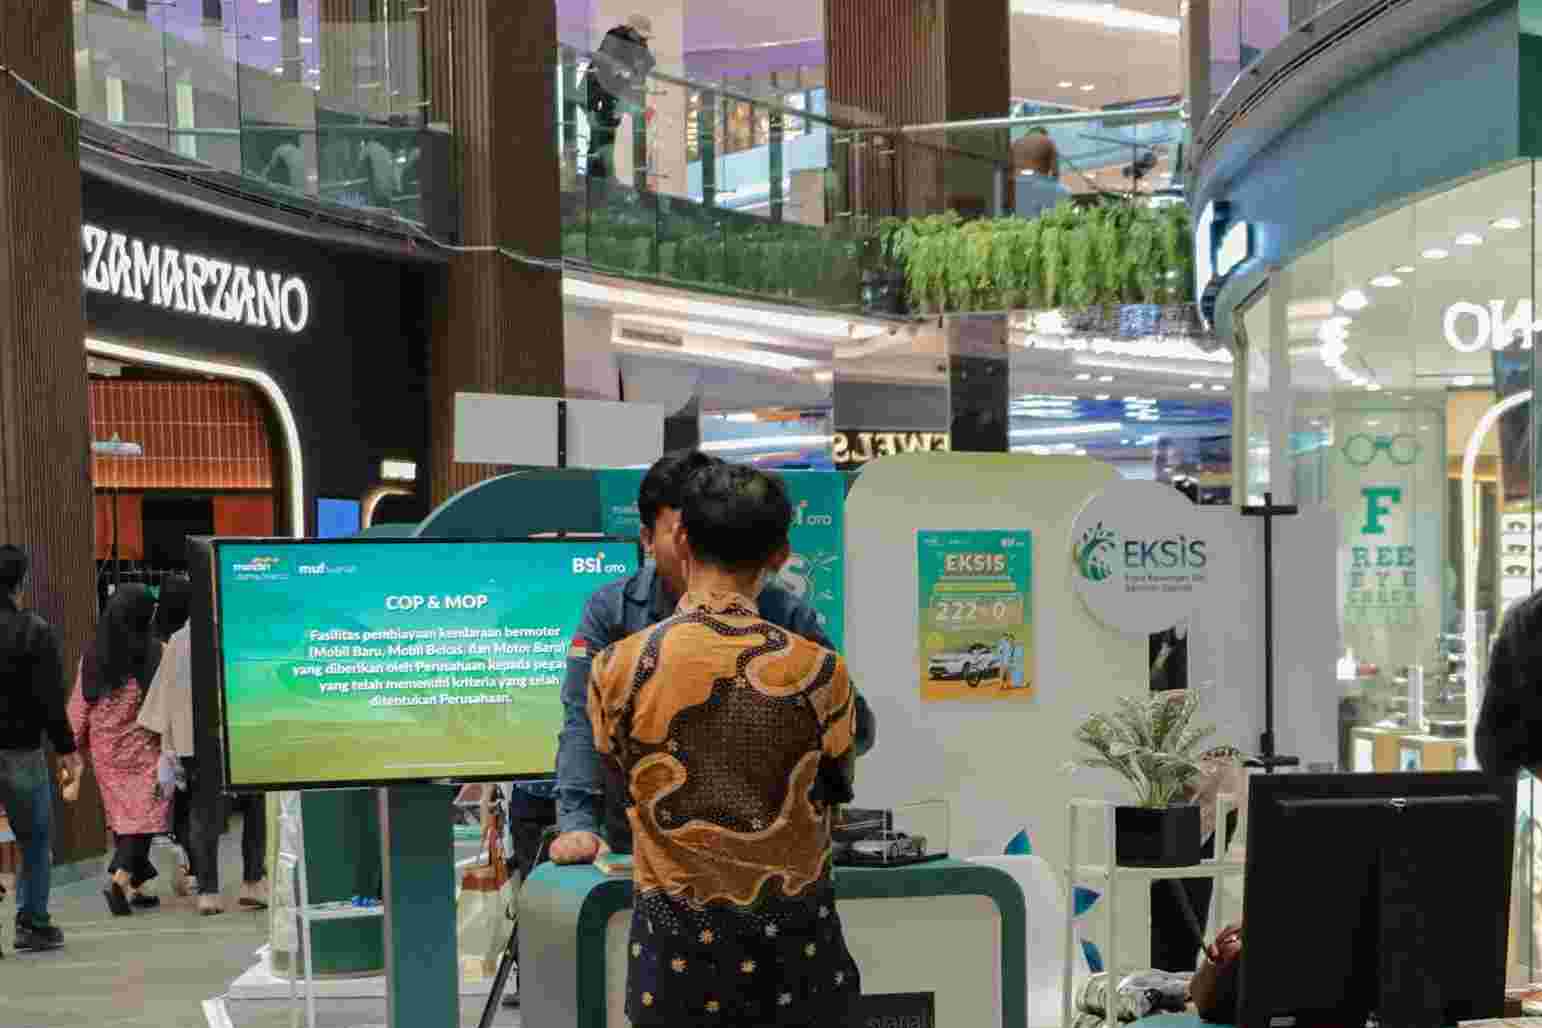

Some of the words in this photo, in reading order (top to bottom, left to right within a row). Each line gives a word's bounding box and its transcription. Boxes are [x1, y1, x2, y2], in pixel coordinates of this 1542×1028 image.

[1361, 488, 1401, 535] F
[572, 553, 604, 574] BSI
[605, 563, 626, 573] OTO
[945, 553, 1006, 572] EKSIS
[1352, 546, 1415, 567] REE
[385, 594, 425, 610] COP
[427, 595, 441, 609] &
[444, 593, 489, 609] MOP
[505, 626, 560, 638] bermotor
[388, 643, 424, 656] Mobil
[494, 642, 531, 655] Motor
[293, 664, 322, 677] yang
[325, 662, 385, 674] diberikan
[319, 681, 351, 694] yang
[451, 676, 497, 689] kriteria
[497, 678, 528, 692] yang
